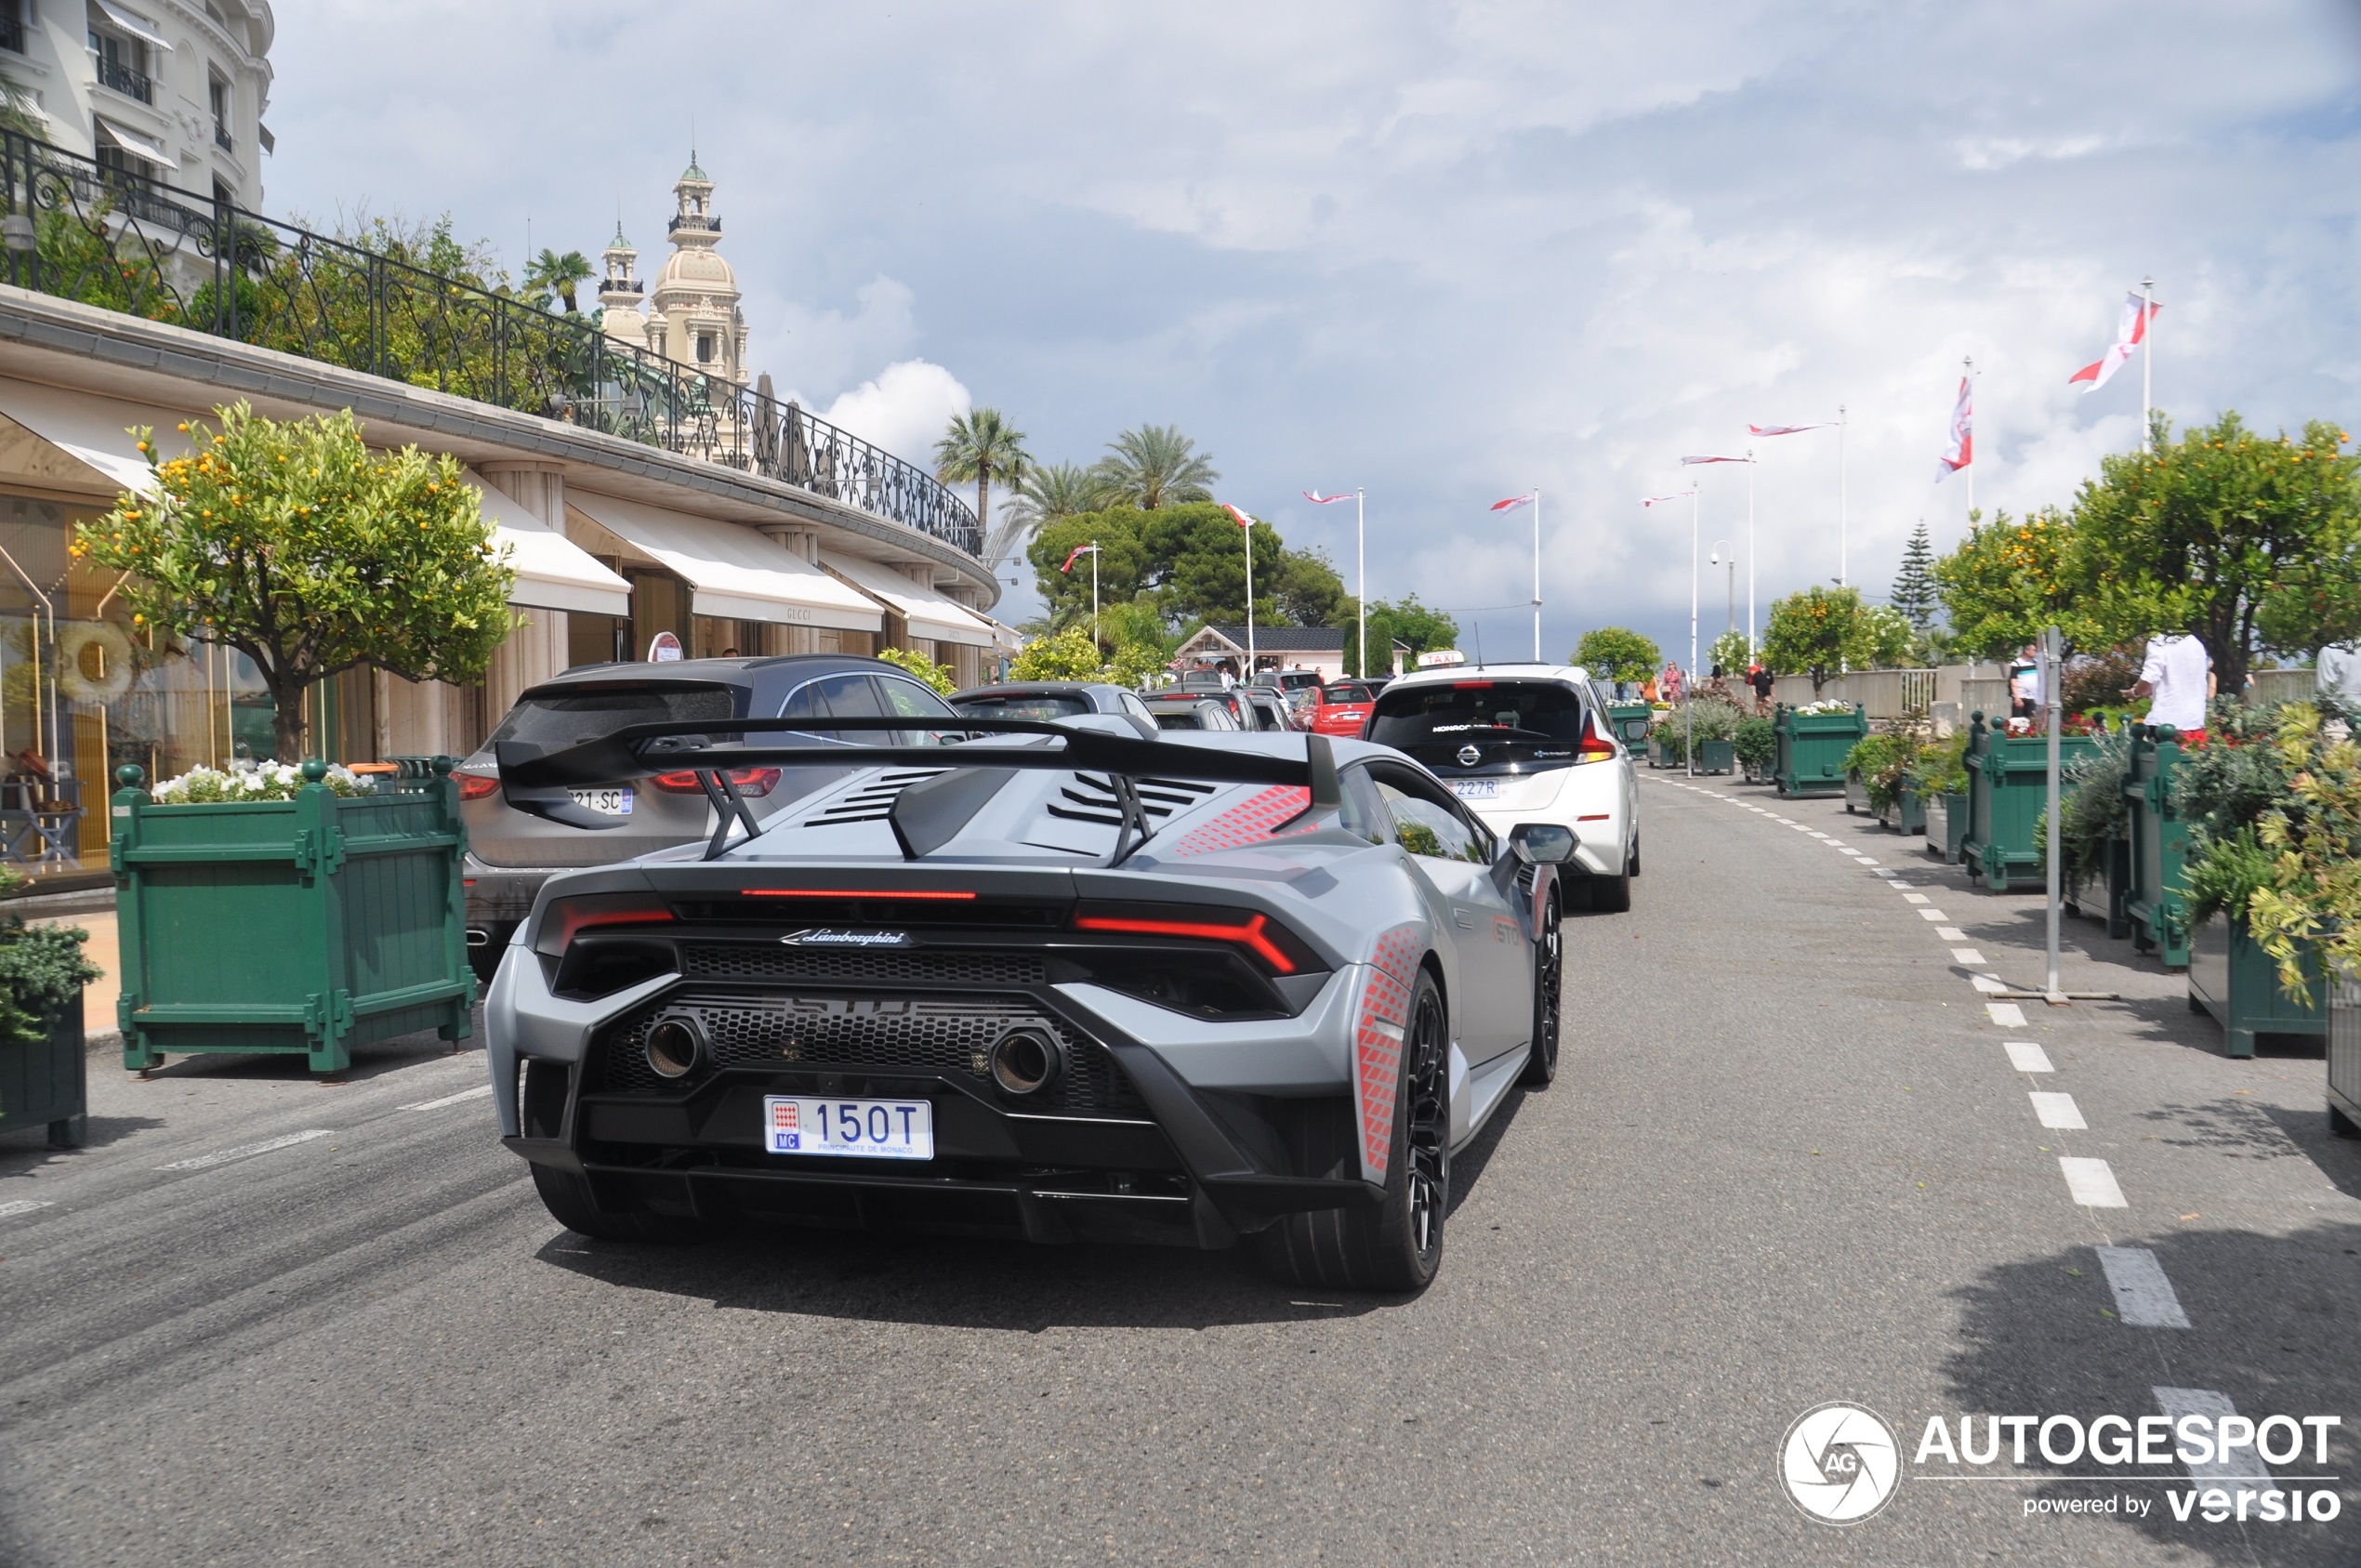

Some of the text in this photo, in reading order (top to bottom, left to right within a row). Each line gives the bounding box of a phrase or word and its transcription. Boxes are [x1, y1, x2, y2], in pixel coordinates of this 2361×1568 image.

[786, 607, 811, 621] GUCCI
[1427, 653, 1456, 664] TAXI
[1457, 781, 1495, 796] 227R
[802, 928, 904, 946] Lamborghini
[1497, 922, 1520, 946] STO
[817, 1103, 917, 1145] 150T
[779, 1134, 796, 1148] MC
[817, 1143, 865, 1153] PRINCIPAUTE
[880, 1146, 914, 1154] MONACO
